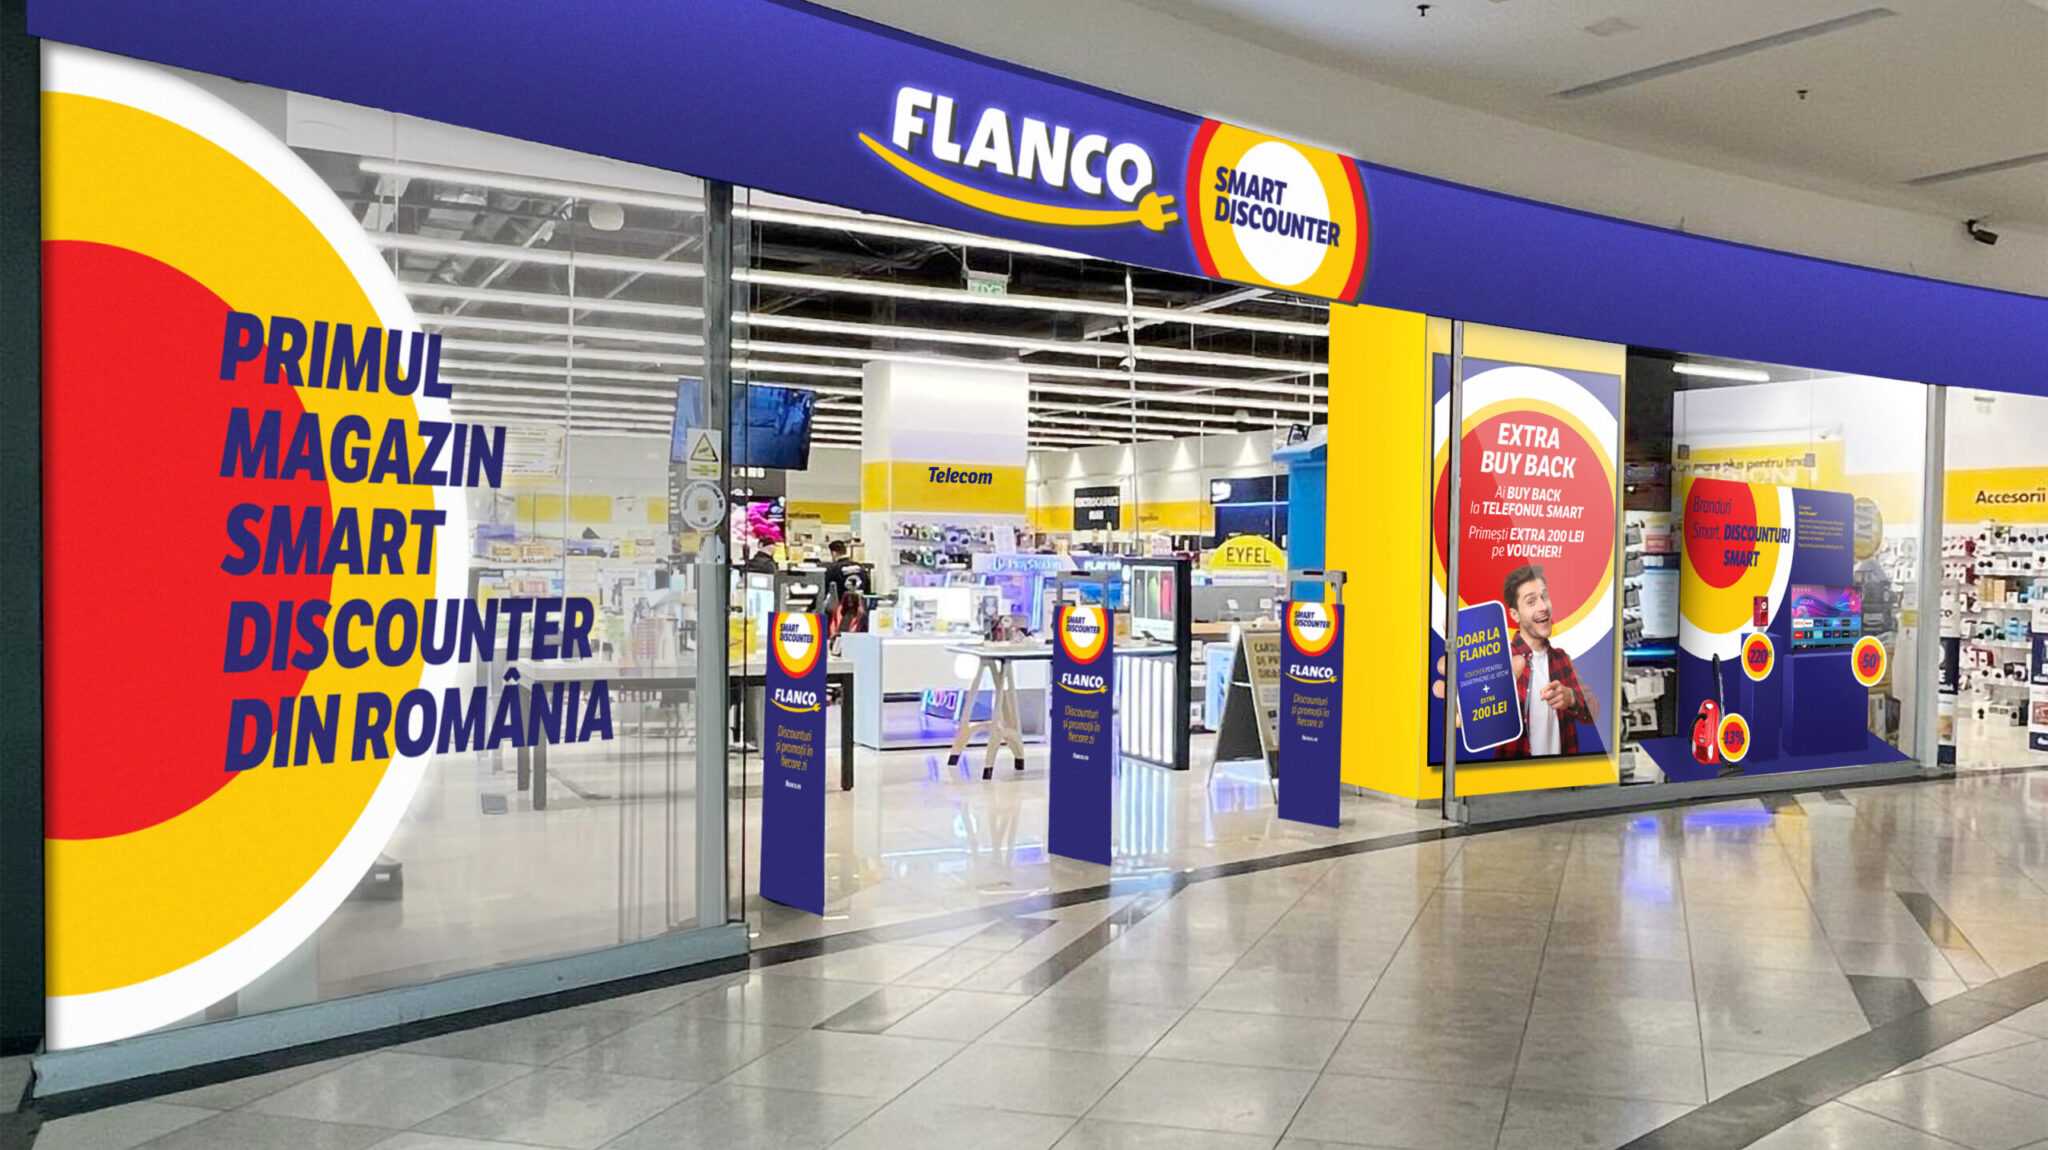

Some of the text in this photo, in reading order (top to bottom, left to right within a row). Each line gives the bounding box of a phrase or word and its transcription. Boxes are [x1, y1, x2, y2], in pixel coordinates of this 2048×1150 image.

[892, 86, 1154, 203] FLANCO
[1215, 166, 1287, 205] SMART
[1215, 195, 1340, 248] DISCOUNTER
[219, 310, 454, 399] PRIMUL
[1498, 422, 1560, 449] EXTRA
[220, 407, 506, 488] MAGAZIN
[1480, 450, 1576, 479] BUY BACK
[928, 466, 993, 485] Telecom
[1495, 486, 1561, 502] Ai BUY BACK
[1975, 487, 2047, 505] Accesorii
[1470, 501, 1584, 519] la TELEFONUL SMART
[1693, 495, 1732, 515] Branduri
[220, 502, 446, 576] SMART
[1468, 525, 1584, 543] Primești EXTRA 200 LEI
[1692, 521, 1791, 544] Smart, DISCOUNTURI
[1226, 547, 1272, 564] EYFEL
[1491, 544, 1562, 559] pe VOUCHER!
[1723, 550, 1760, 568] SMART
[1066, 615, 1086, 624] SMART
[1294, 610, 1315, 620] SMART
[1294, 619, 1331, 629] DISCOUNTER
[223, 596, 595, 673] DISCOUNTER
[780, 623, 800, 633] SMART
[1066, 624, 1100, 634] DISCOUNTER
[1457, 626, 1500, 648] DOAR LA
[779, 633, 814, 644] DISCOUNTER
[1460, 642, 1501, 663] FLANCO
[1290, 664, 1334, 678] FLANCO
[1061, 672, 1103, 689] FLANCO
[775, 688, 818, 706] FLANCO
[1293, 693, 1329, 707] Discounturi
[1480, 694, 1496, 704] EXTRA
[224, 667, 614, 772] DIN ROMÂNIA
[1064, 705, 1098, 719] Discounturi
[1472, 700, 1507, 722] 200 LEI
[777, 725, 812, 742] Discounturi
[1721, 730, 1745, 745] -13%
